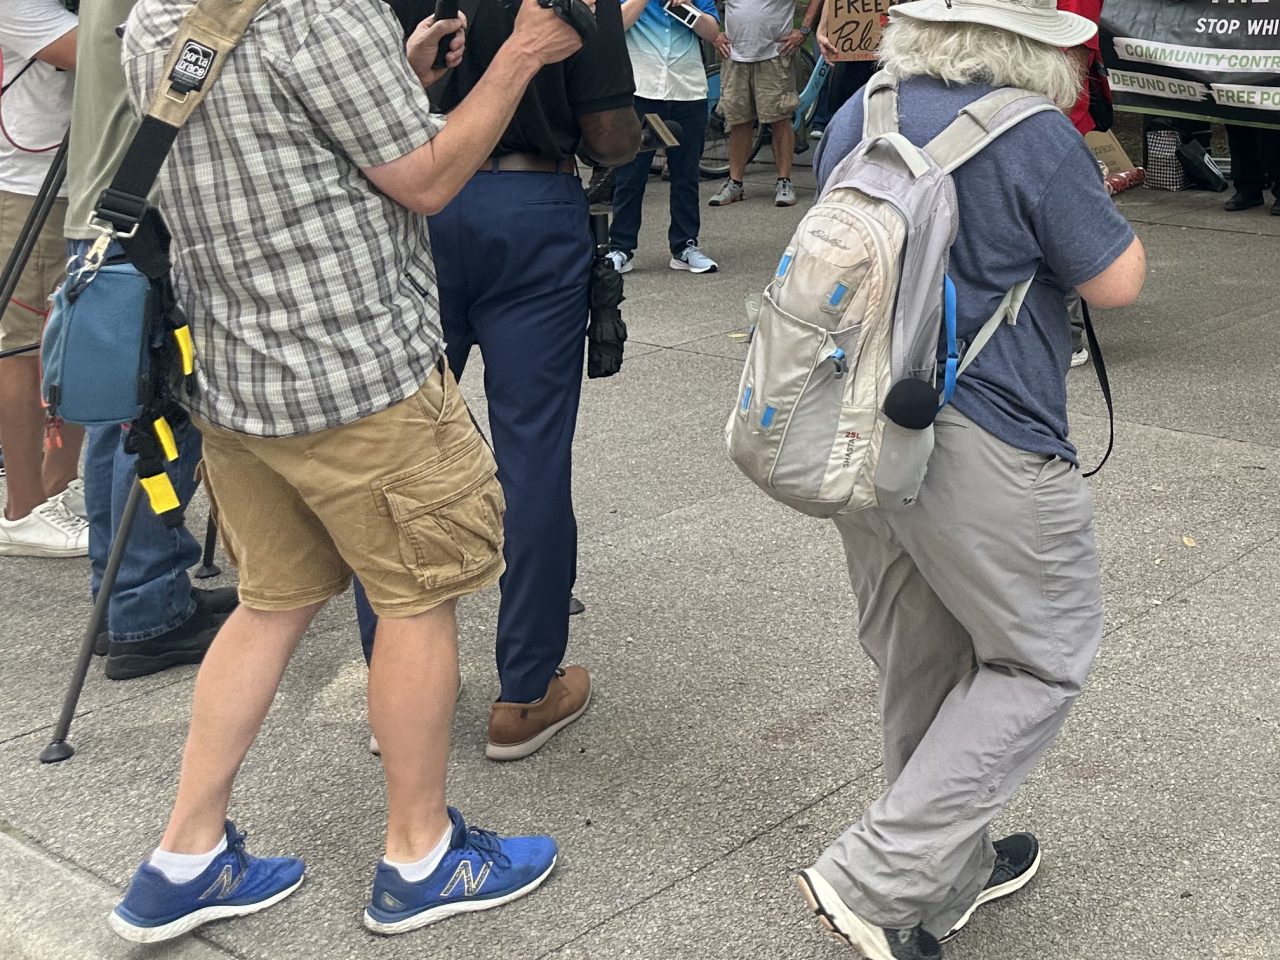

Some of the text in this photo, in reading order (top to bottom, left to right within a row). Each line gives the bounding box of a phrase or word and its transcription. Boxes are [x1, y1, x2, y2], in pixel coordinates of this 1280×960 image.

[1195, 17, 1241, 35] STOP
[1125, 43, 1225, 66] COMMUNITY
[1112, 72, 1197, 98] DEFUND CPD
[1216, 89, 1257, 105] FREE
[845, 431, 862, 439] 25L
